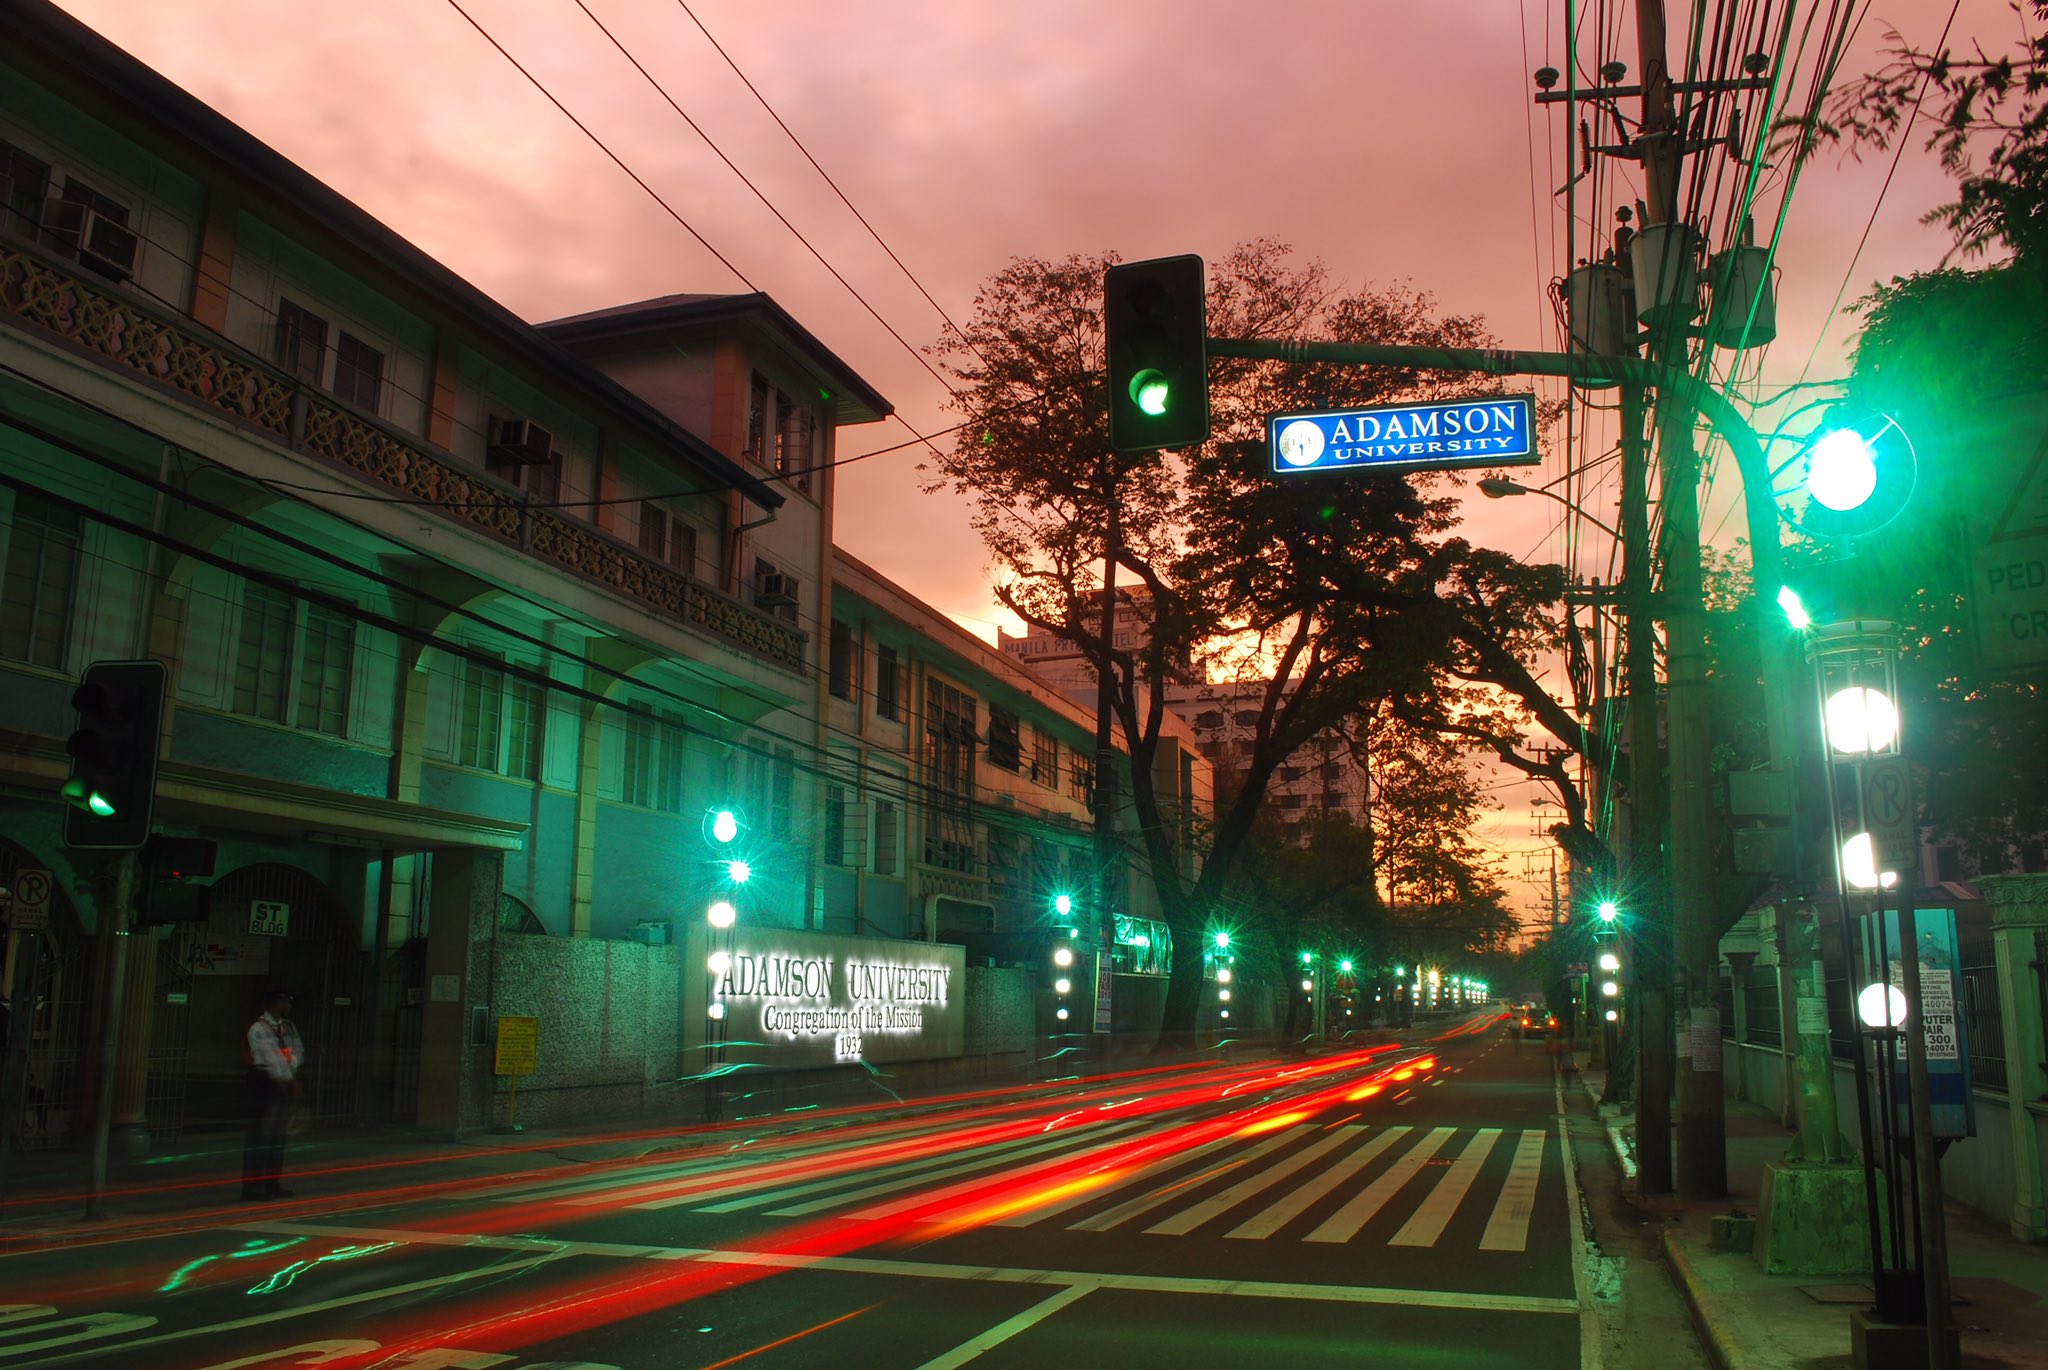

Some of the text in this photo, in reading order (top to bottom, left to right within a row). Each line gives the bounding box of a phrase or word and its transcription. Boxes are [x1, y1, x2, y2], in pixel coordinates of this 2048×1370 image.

[1330, 405, 1518, 445] ADAMSON
[1333, 436, 1514, 460] UNIVERSITY
[1005, 639, 1048, 654] MANILA
[717, 955, 952, 1002] ADAMSON UNIVERSITY
[764, 1005, 924, 1036] Congregation of the Mission
[839, 1036, 863, 1056] 1932
[1929, 1035, 1951, 1044] 300
